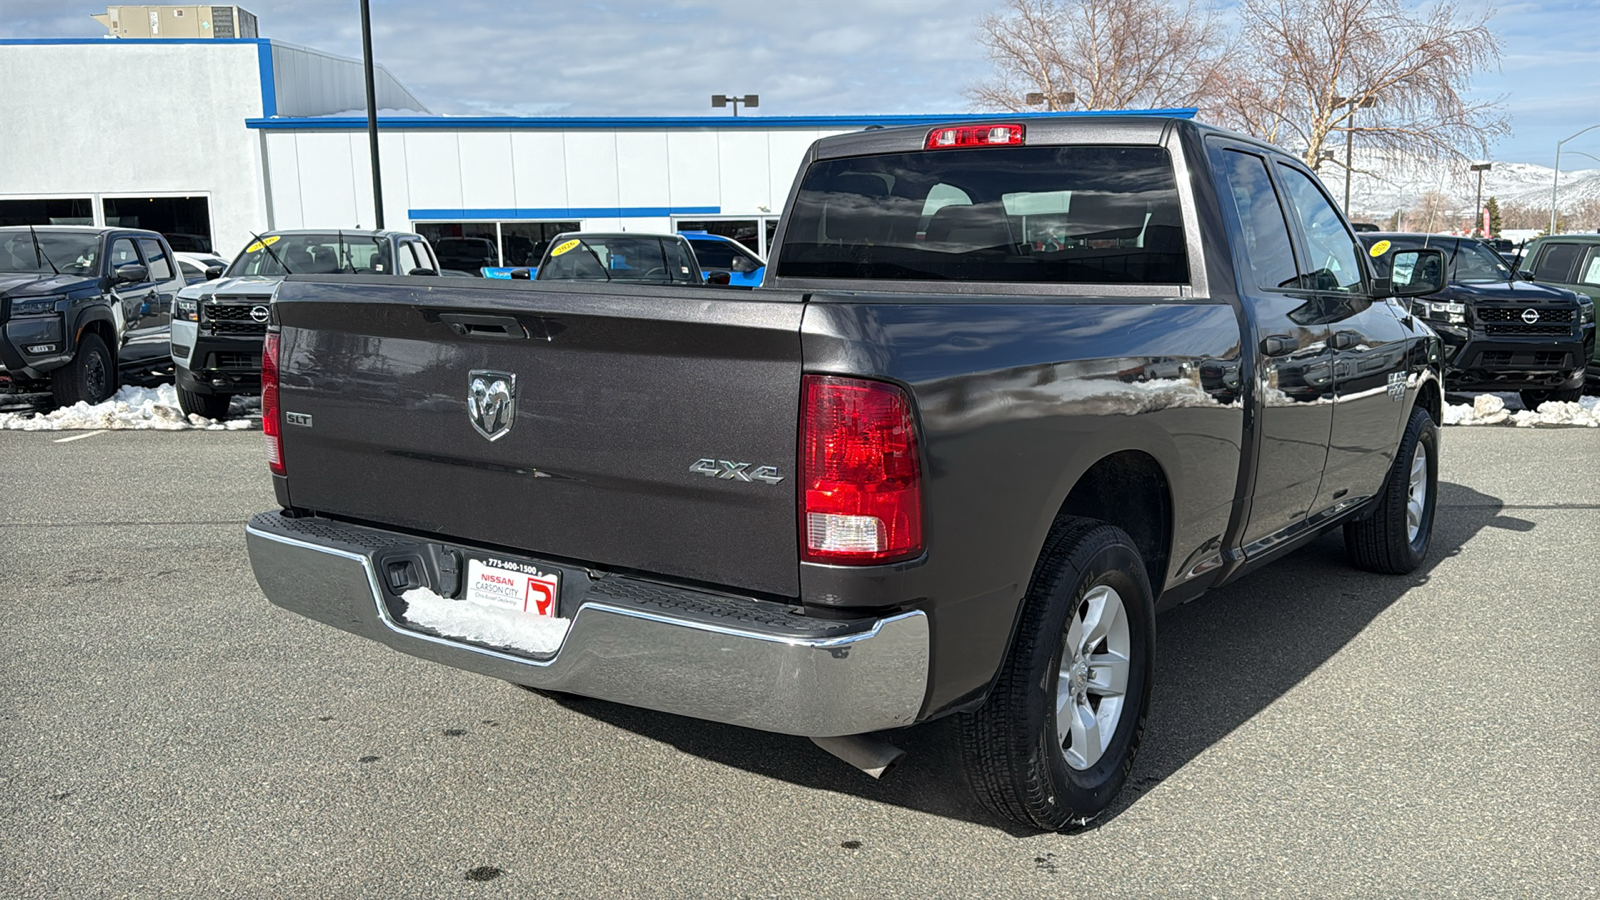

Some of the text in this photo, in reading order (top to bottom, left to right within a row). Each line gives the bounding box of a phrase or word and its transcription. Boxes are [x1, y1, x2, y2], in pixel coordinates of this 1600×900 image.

[287, 413, 312, 425] SLT
[488, 558, 537, 575] 775-600-1500
[481, 573, 514, 587] NISSAN
[475, 581, 519, 598] CARSON CITY
